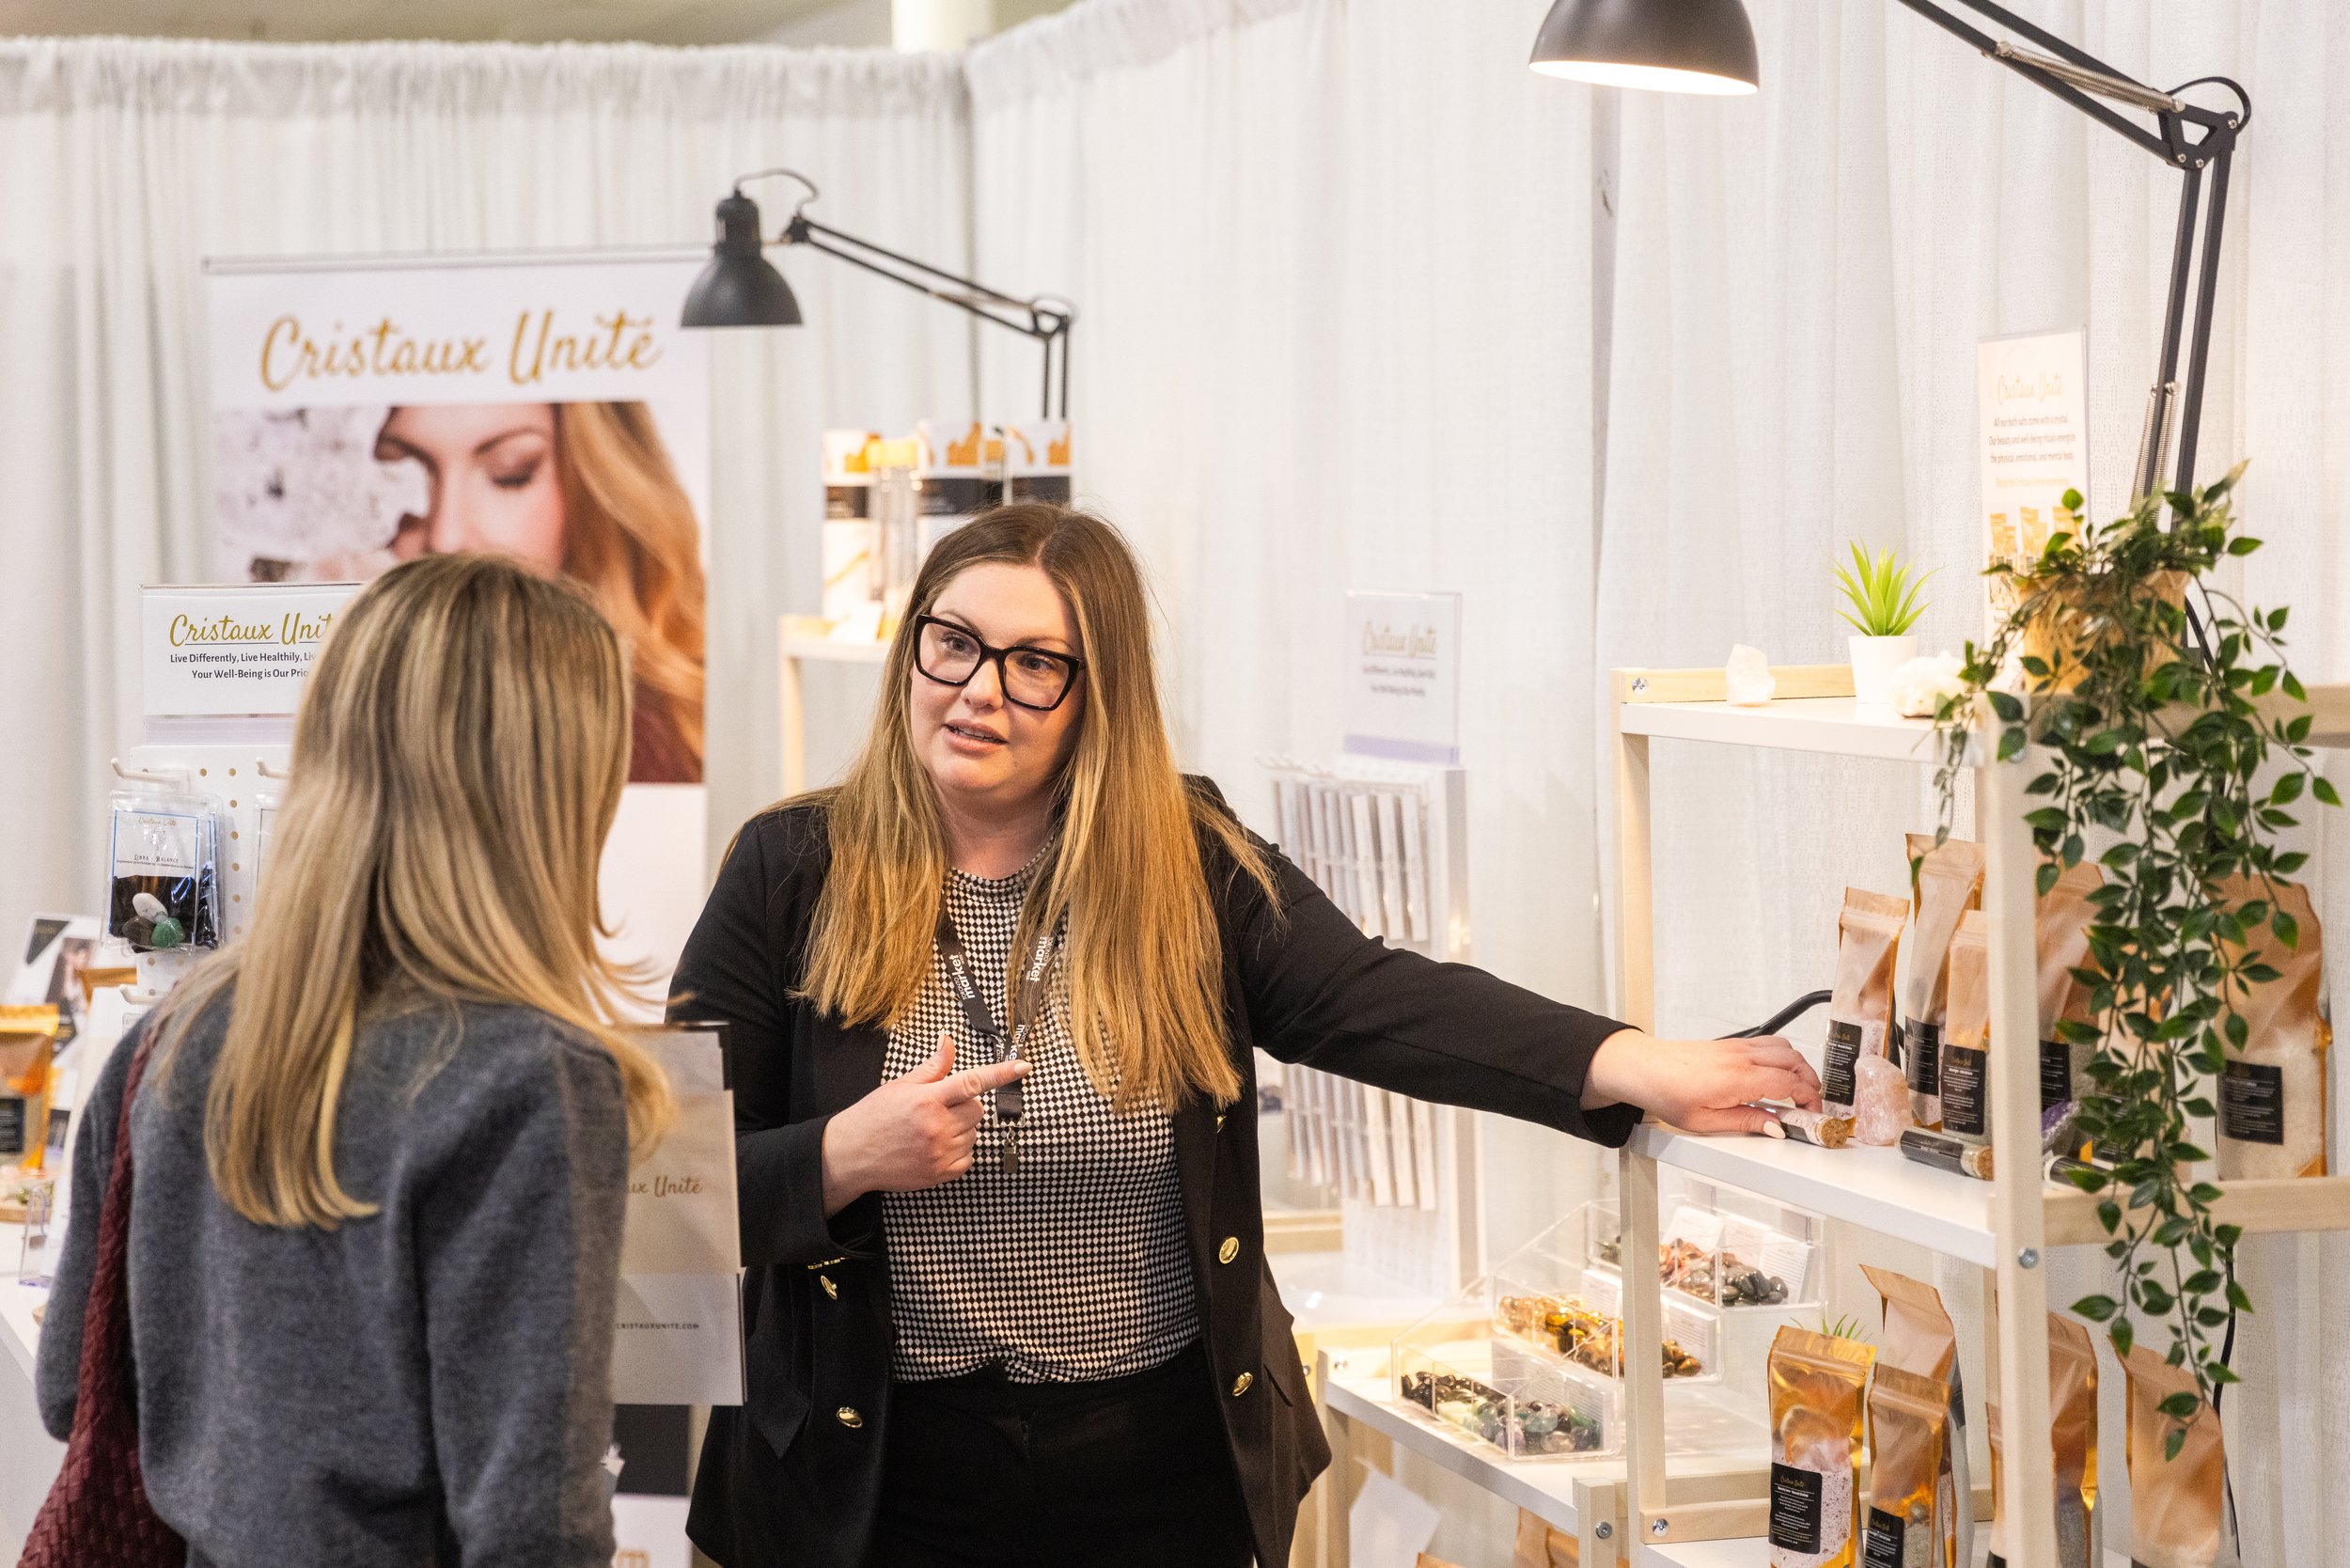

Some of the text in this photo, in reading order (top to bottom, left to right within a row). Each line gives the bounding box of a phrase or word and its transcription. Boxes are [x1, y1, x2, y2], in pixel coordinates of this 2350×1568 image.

[260, 309, 662, 392] Cristaux Unité
[169, 613, 333, 647] Cristaux Unit
[170, 652, 317, 664] Live Differently, Live Healthily, Liv
[192, 669, 212, 679] Your
[213, 669, 263, 680] Well-Being
[264, 668, 272, 678] is
[272, 668, 289, 678] Our
[1029, 936, 1048, 982] market
[948, 954, 976, 999] market
[654, 1175, 703, 1198] Unité
